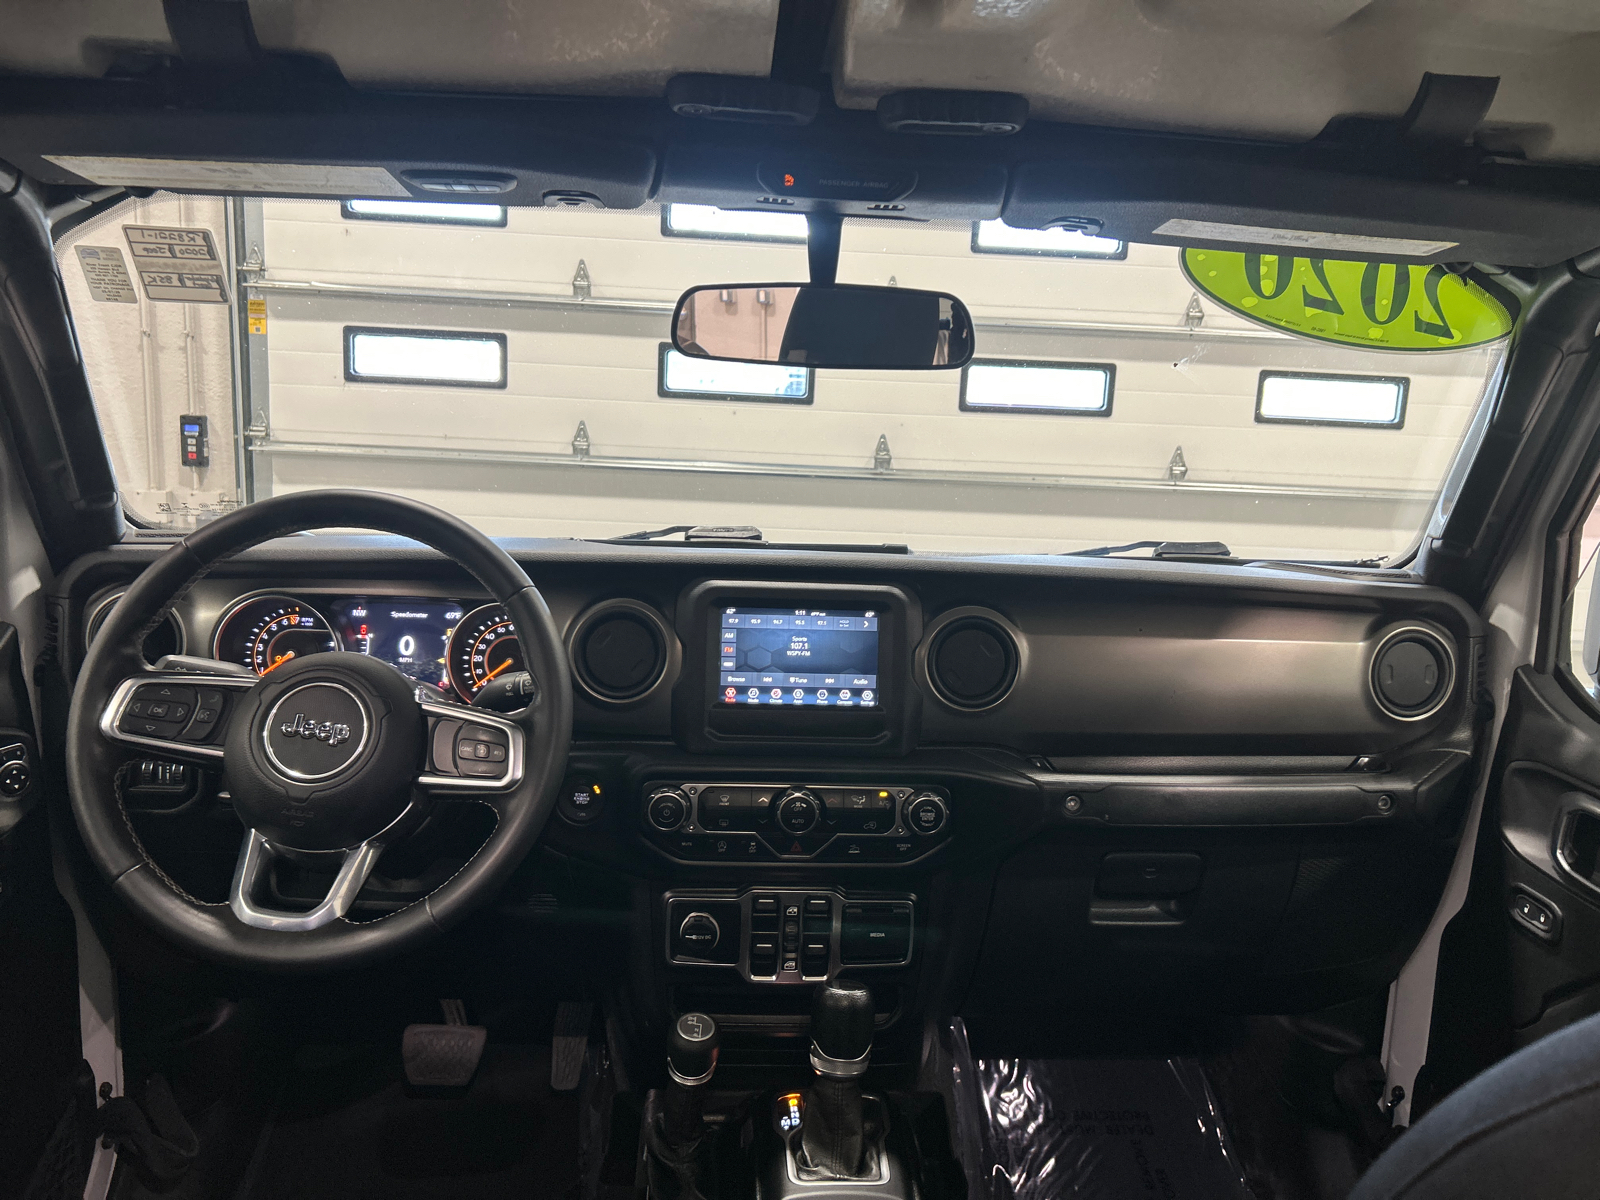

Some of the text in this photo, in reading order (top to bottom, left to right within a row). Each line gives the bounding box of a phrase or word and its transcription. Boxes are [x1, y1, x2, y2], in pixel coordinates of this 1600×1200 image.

[819, 179, 889, 189] PASSENGER AIRBAG
[390, 611, 429, 619] Speedometer
[281, 618, 288, 626] 6
[270, 623, 277, 631] 5
[262, 632, 268, 640] 4
[484, 632, 495, 640] 40
[257, 643, 264, 651] 3
[399, 635, 415, 656] 0
[790, 642, 808, 650] 107.1
[256, 655, 263, 663] 2
[280, 712, 351, 747] Jeep
[790, 1111, 800, 1119] N
[780, 1118, 791, 1127] M
[791, 1118, 801, 1126] D
